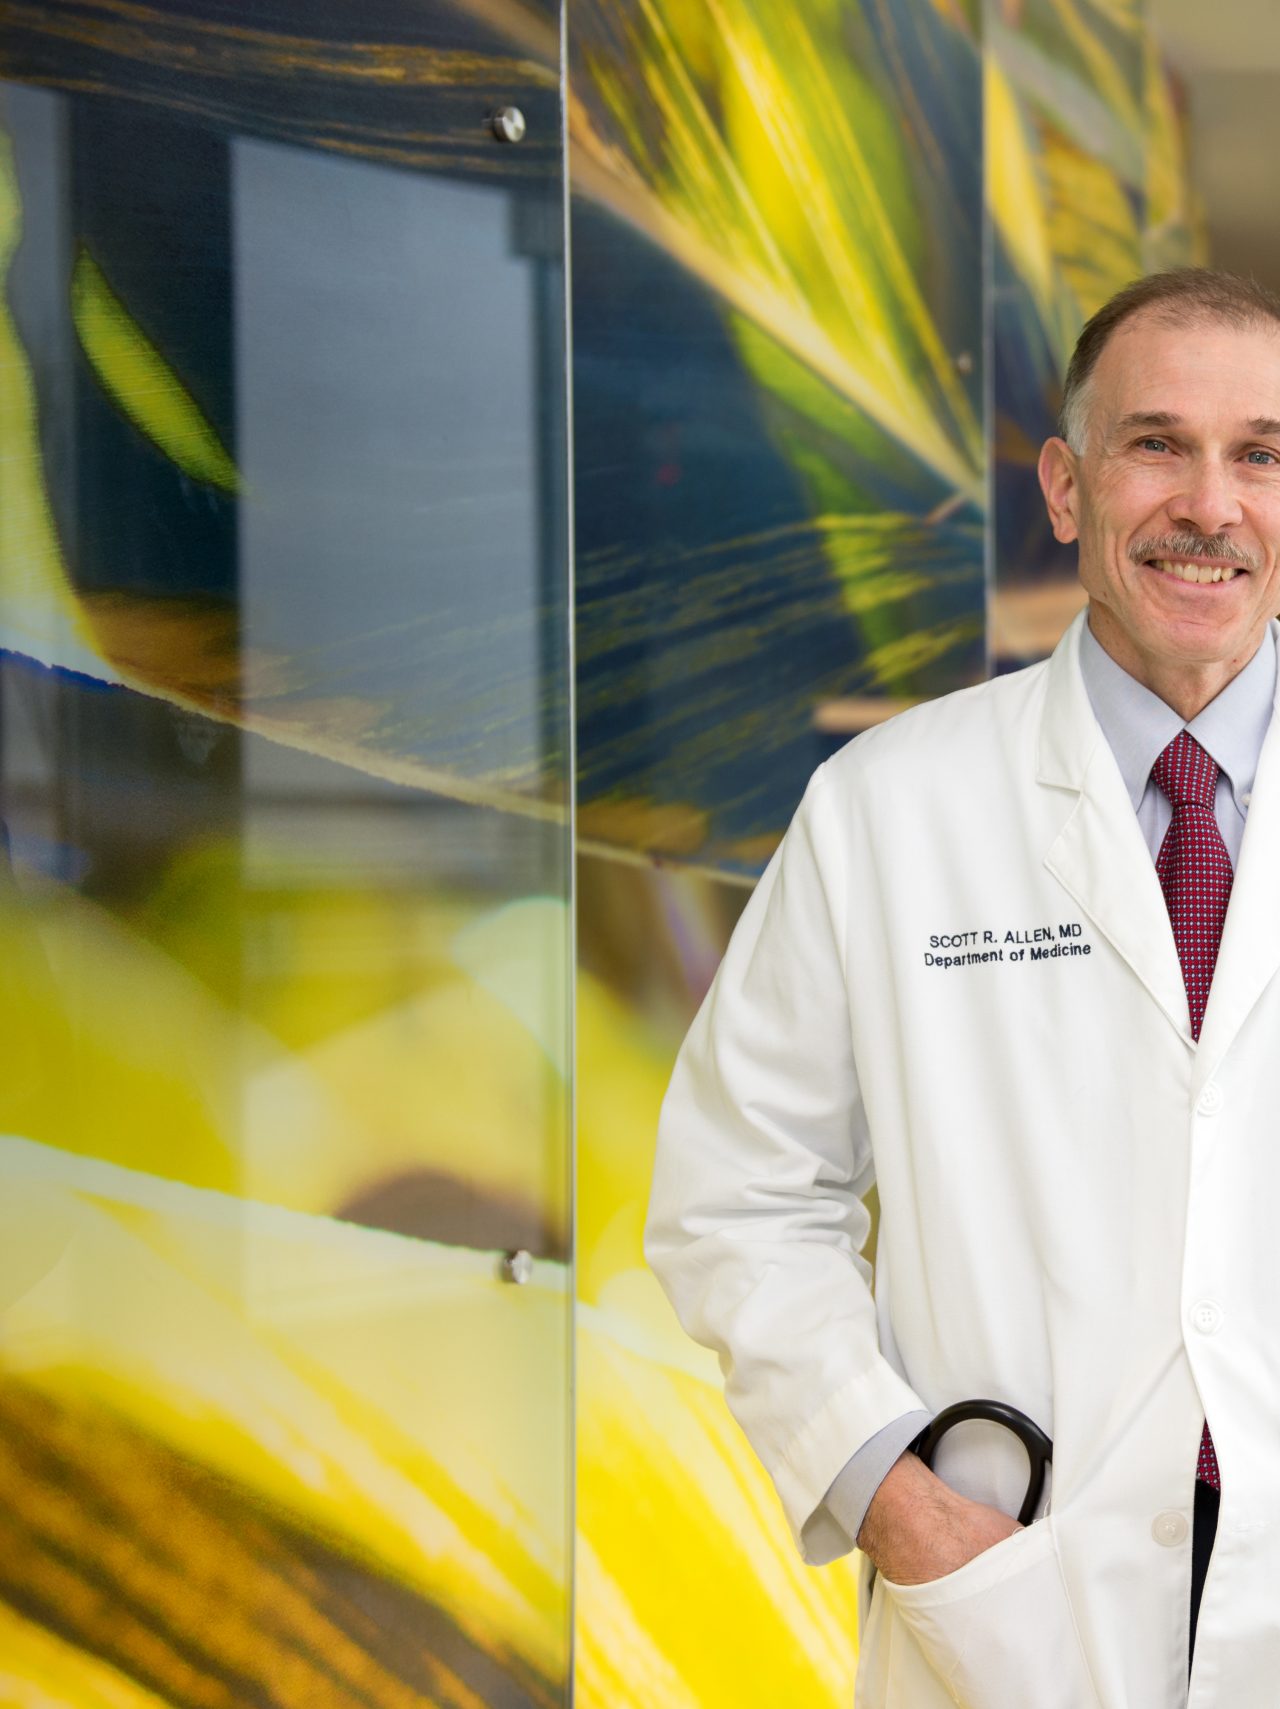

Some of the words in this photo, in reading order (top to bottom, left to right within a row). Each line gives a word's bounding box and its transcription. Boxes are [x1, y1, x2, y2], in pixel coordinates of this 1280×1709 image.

[929, 932, 978, 948] SCOTT
[983, 931, 998, 944] R.
[1004, 927, 1055, 944] ALLEN,
[1058, 923, 1082, 938] MD
[924, 949, 1003, 969] Department
[1009, 950, 1025, 962] of
[1030, 944, 1091, 961] Medicine
